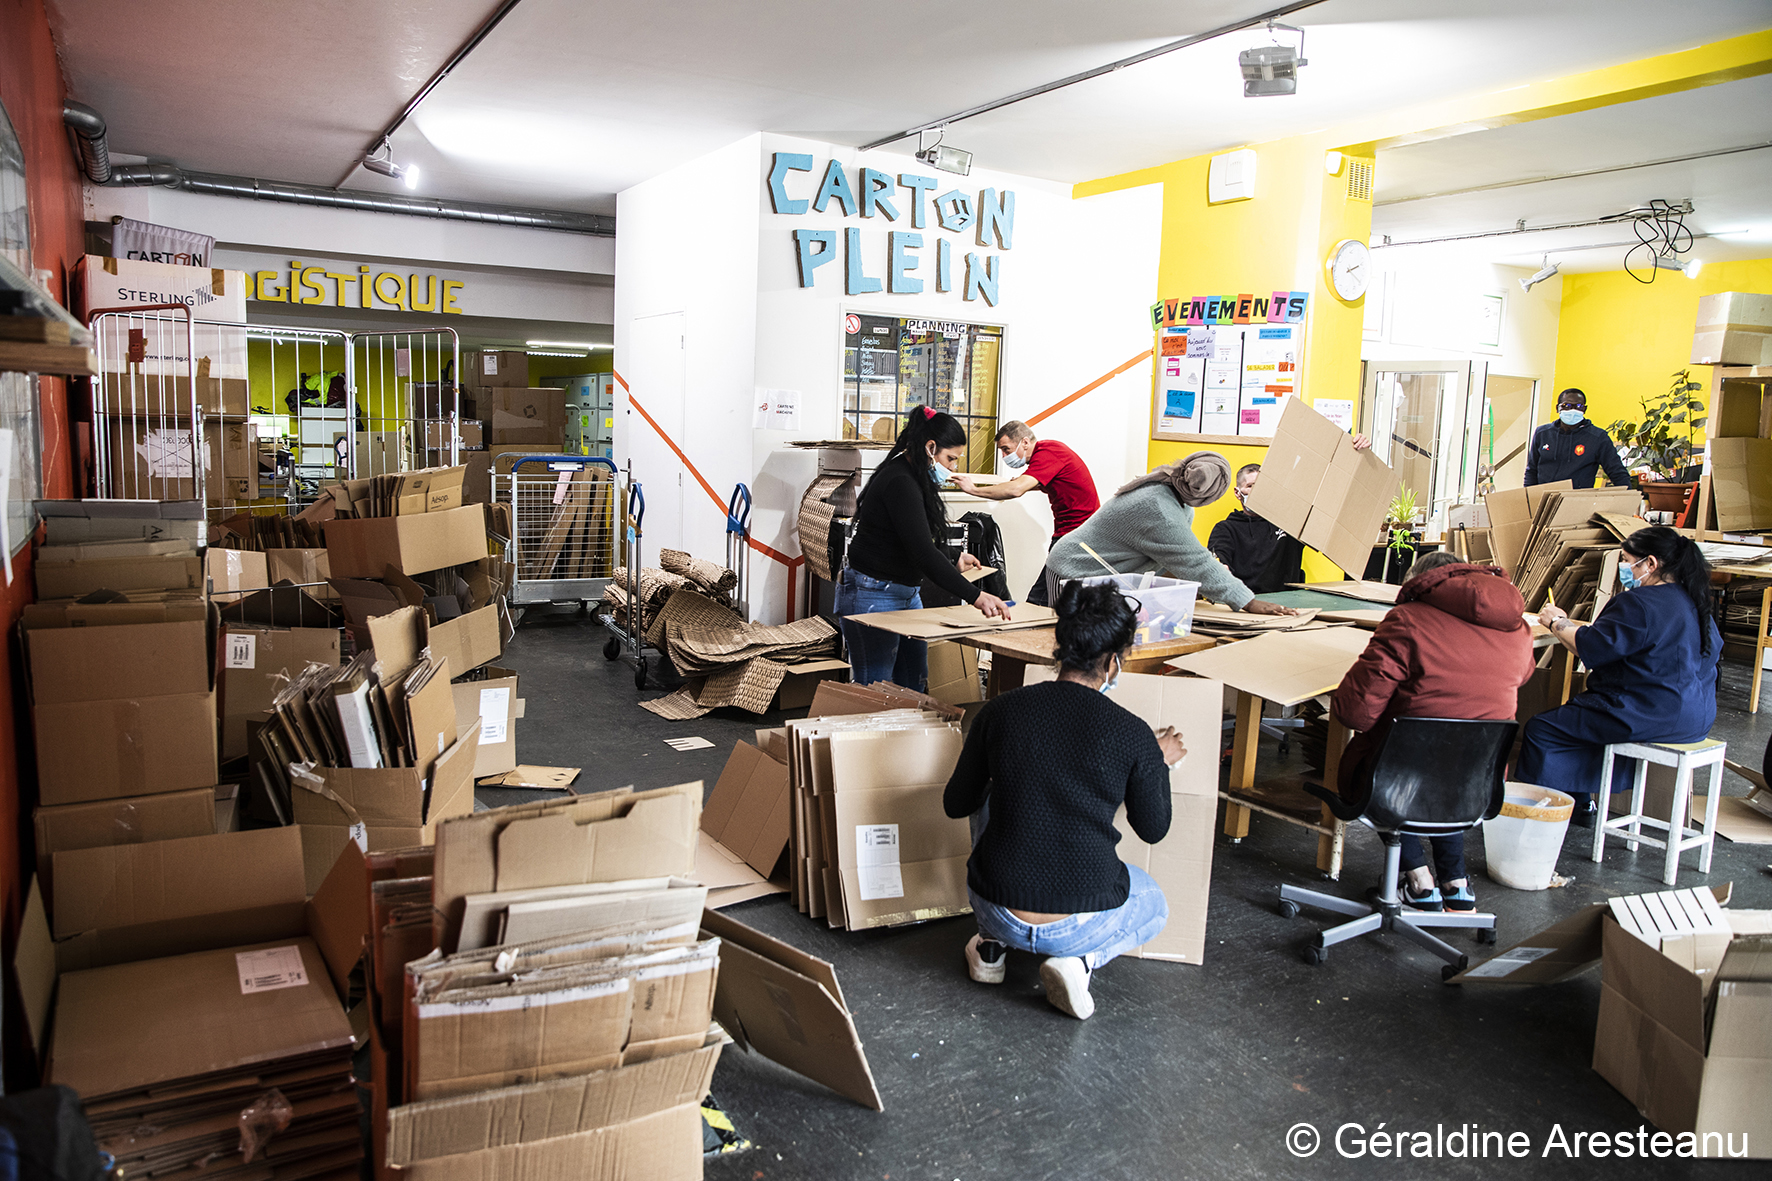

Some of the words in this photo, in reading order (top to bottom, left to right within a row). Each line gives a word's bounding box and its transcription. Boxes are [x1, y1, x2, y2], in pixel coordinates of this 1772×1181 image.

[767, 152, 1015, 250] CARTON
[792, 227, 1000, 307] PLEIN
[118, 288, 195, 306] STERLING
[1154, 297, 1305, 325] ÉVENEMENTS
[908, 320, 966, 334] PLANNING
